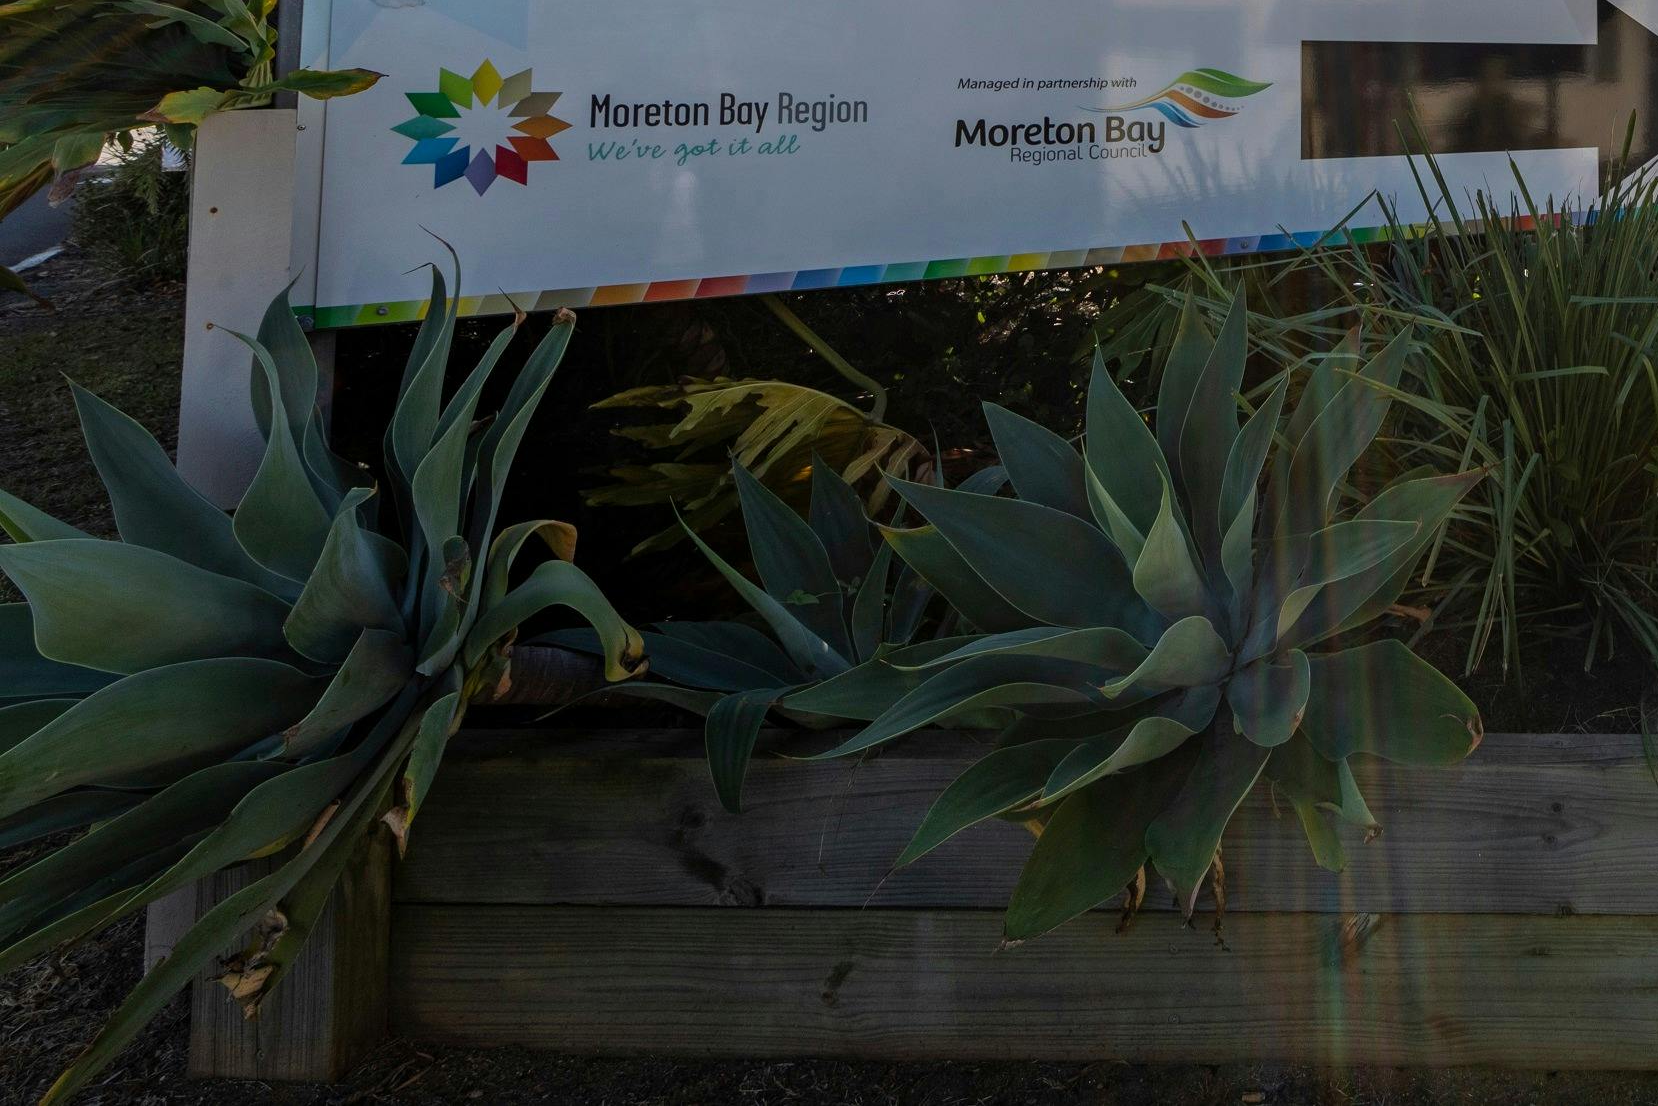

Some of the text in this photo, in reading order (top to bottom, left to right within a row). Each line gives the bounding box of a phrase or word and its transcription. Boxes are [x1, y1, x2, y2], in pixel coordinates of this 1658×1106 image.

[957, 77, 1137, 91] Managed in partnership with
[590, 92, 867, 133] Moreton Bay Region
[588, 134, 800, 166] We've got it all
[955, 116, 1165, 153] Moreton Bay
[1010, 143, 1148, 166] Regional Council
